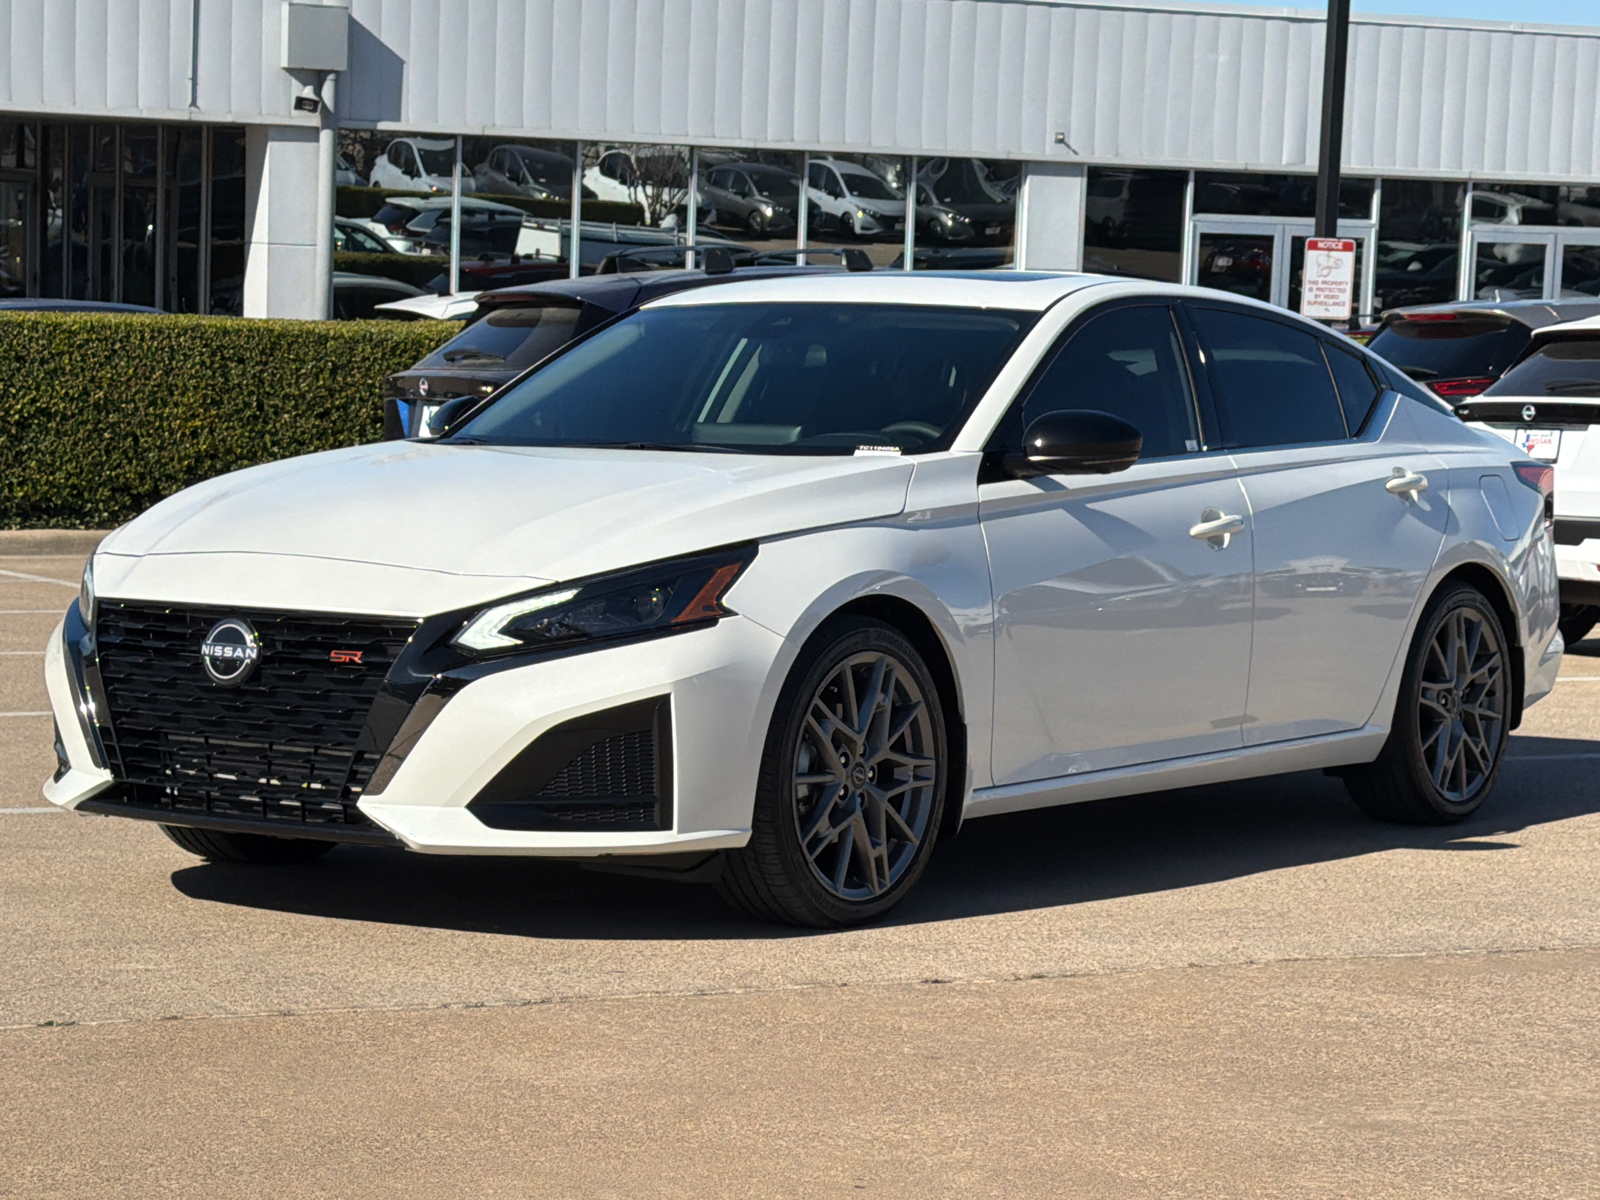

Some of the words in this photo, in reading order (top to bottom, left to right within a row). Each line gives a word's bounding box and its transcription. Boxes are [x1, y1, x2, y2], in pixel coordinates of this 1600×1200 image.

[1317, 241, 1344, 249] NOTICE
[201, 644, 257, 659] NISSAN
[329, 649, 364, 664] SR
